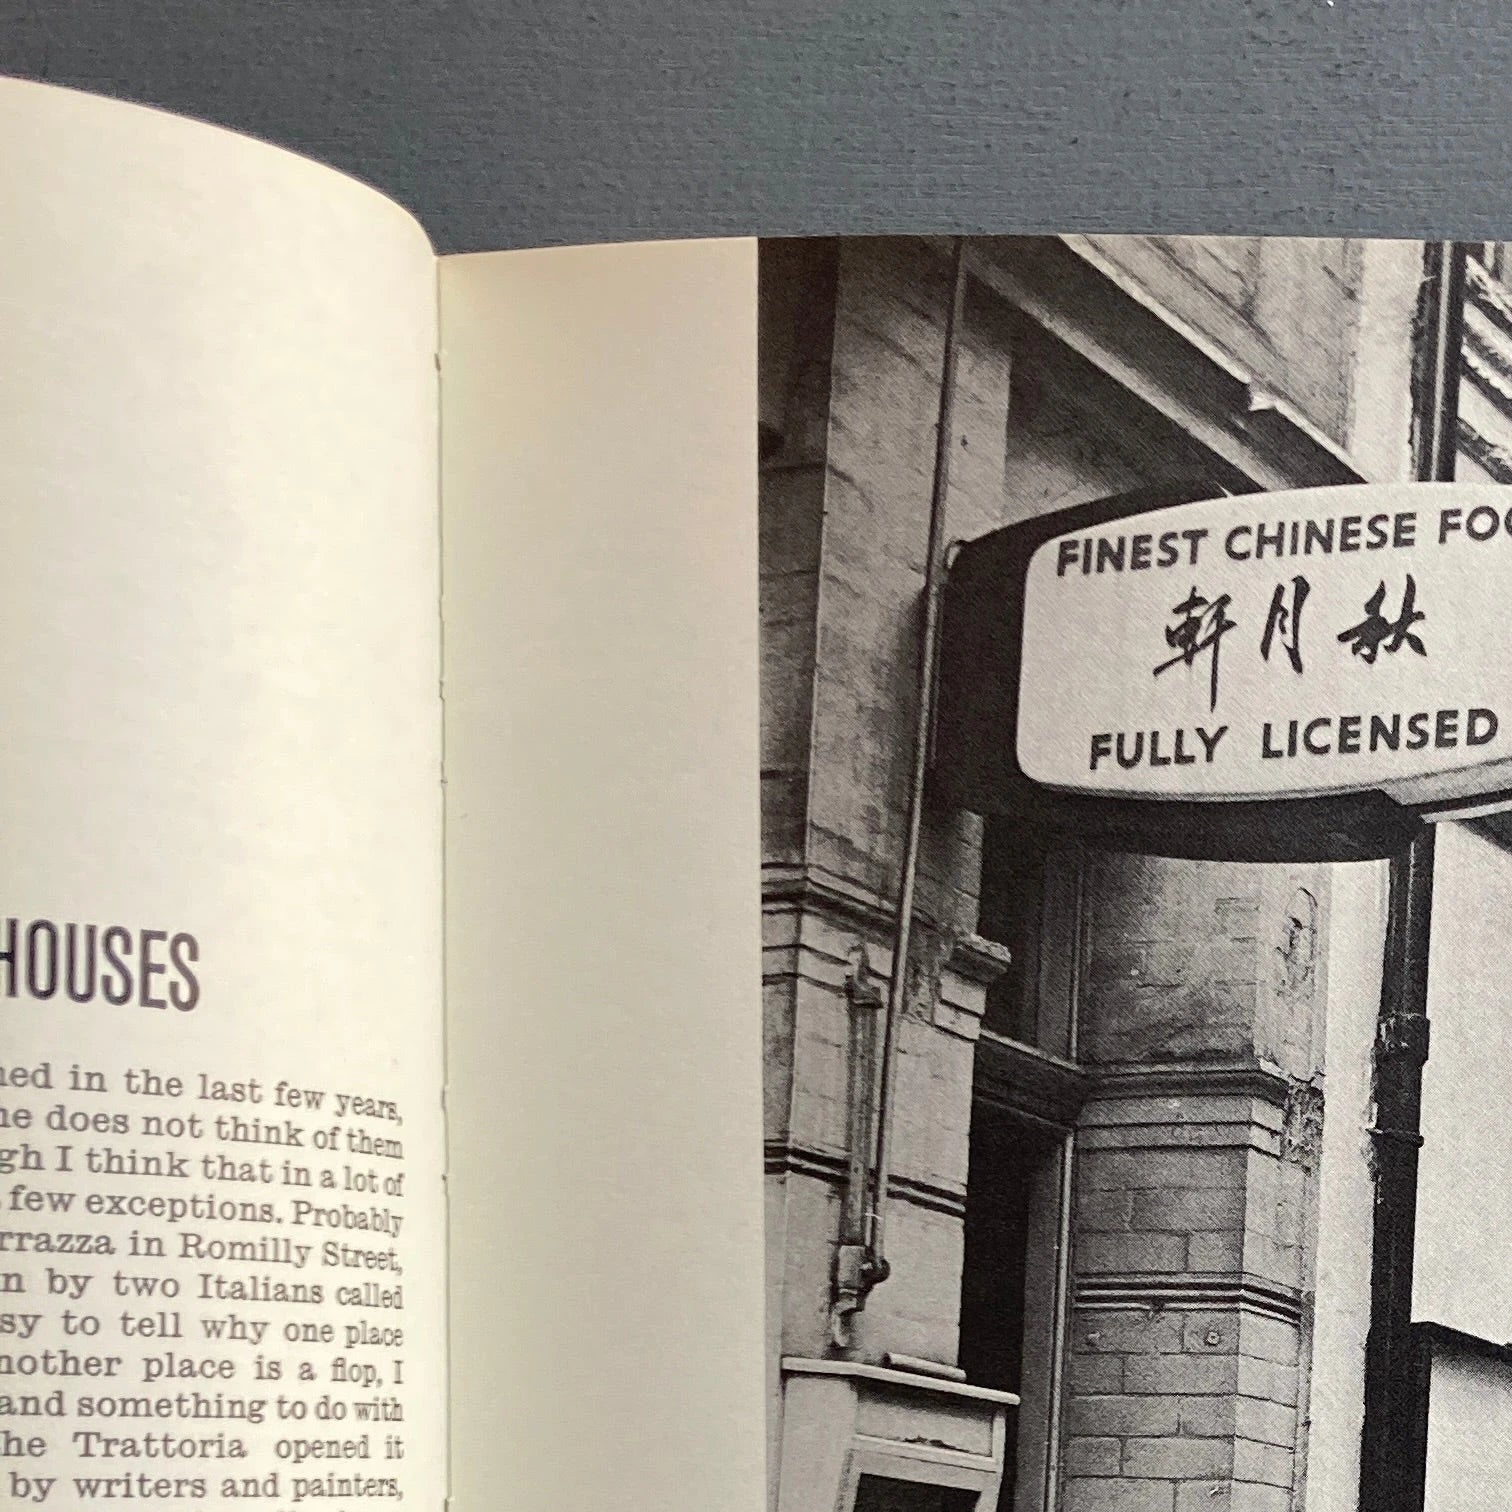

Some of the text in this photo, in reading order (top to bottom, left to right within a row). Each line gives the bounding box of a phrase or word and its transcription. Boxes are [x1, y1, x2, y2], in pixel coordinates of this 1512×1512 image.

[1055, 529, 1209, 576] FINEST
[1224, 512, 1417, 562] CHINESE
[1089, 707, 1500, 769] FULLY LICENSED
[70, 1065, 107, 1092] in
[124, 1070, 182, 1097] the
[198, 1074, 262, 1103] last
[275, 1082, 325, 1109] few
[335, 1094, 402, 1125] years,
[46, 1105, 403, 1159] does not think them
[86, 1148, 378, 1193] think that lot
[10, 1185, 403, 1238] few exceptions. Probably
[179, 1233, 312, 1268] Romilly
[322, 1242, 402, 1275] Street,
[46, 1268, 403, 1309] by two Italians called
[61, 1310, 402, 1348] to tell why one place
[142, 1352, 235, 1382] place
[331, 1358, 382, 1387] flop,
[78, 1393, 267, 1424] something
[315, 1396, 346, 1420] do
[353, 1397, 404, 1421] with
[73, 1432, 403, 1463] Trattoria opened it
[8, 1472, 402, 1502] by writers and painters,
